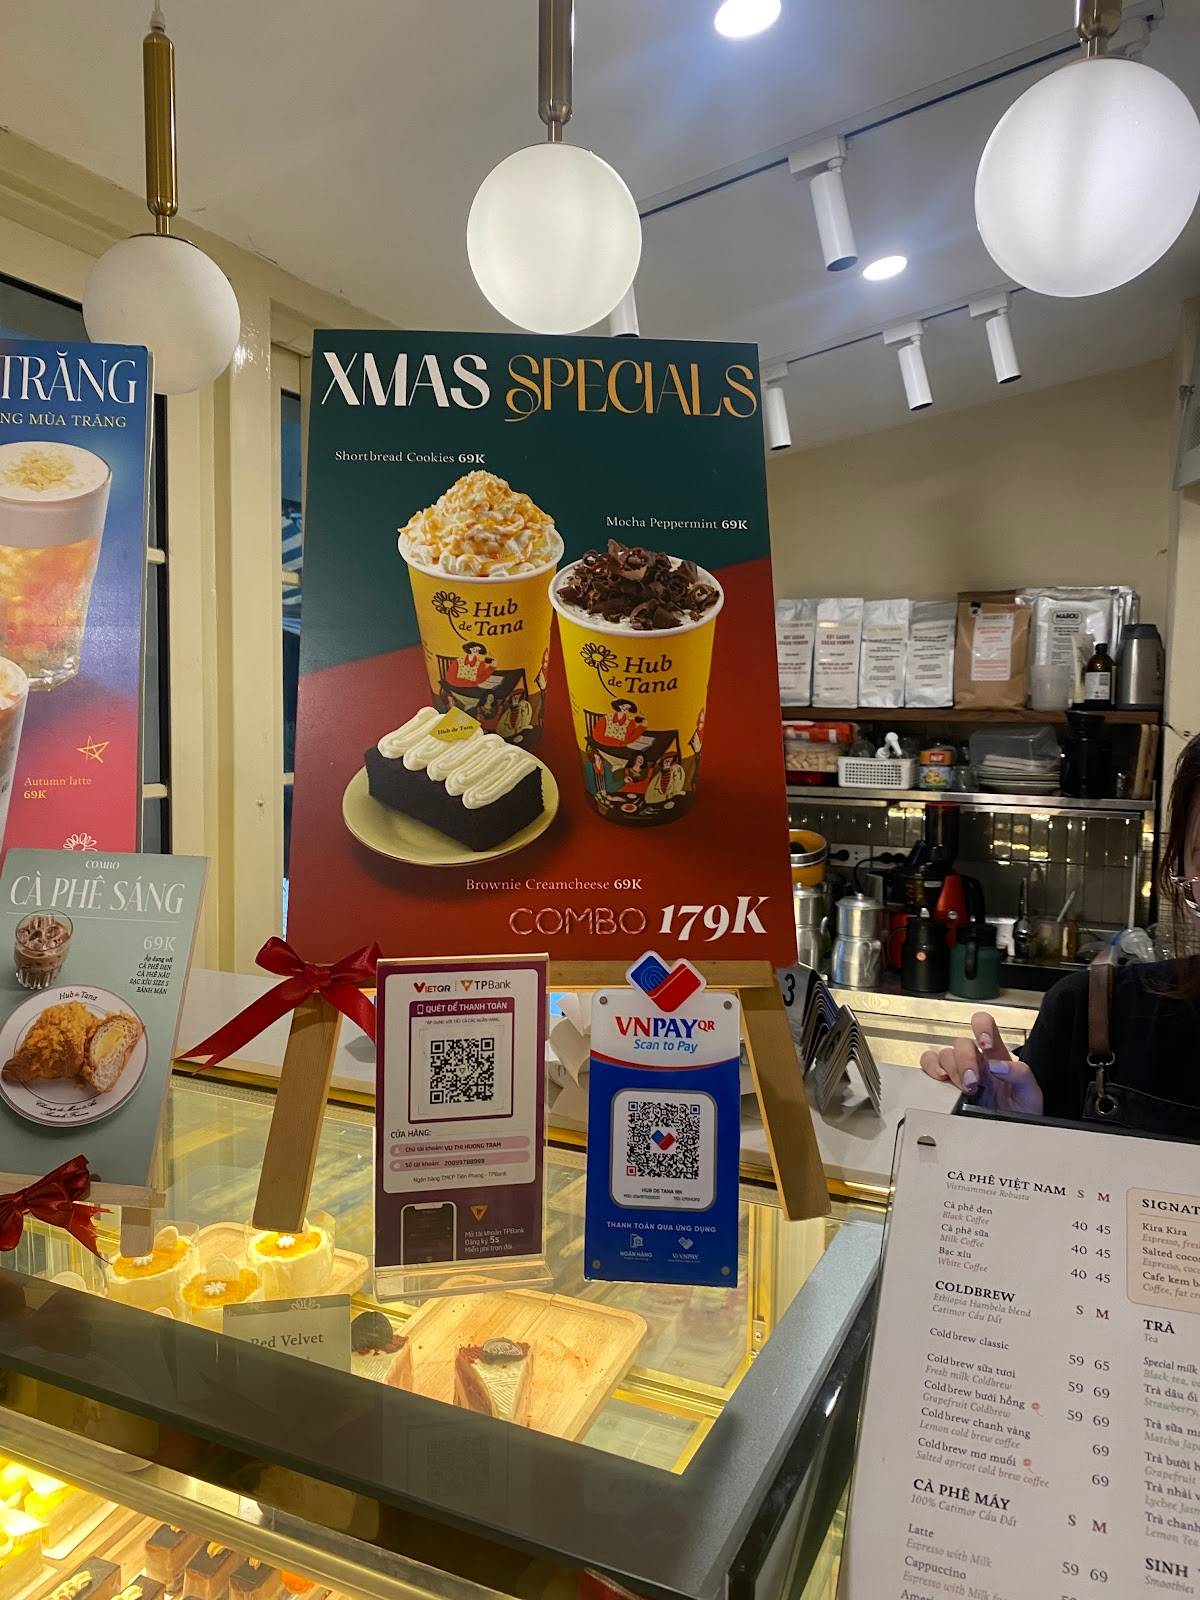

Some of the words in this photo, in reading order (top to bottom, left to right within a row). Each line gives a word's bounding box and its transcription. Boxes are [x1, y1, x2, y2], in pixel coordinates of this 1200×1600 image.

[0, 350, 137, 404] TRĂNG
[321, 351, 491, 411] XMAS
[504, 354, 757, 422] SPECIALS
[29, 411, 66, 426] MÙA
[72, 413, 126, 428] TRĂNG
[335, 449, 403, 463] Shortbread
[407, 450, 455, 464] Cookies
[458, 453, 485, 464] 69K
[606, 515, 646, 529] Mocha
[650, 516, 719, 533] Peppermint
[721, 519, 748, 530] 69K
[472, 598, 518, 618] Hub
[458, 620, 472, 632] de
[474, 617, 523, 636] Tana
[624, 653, 672, 674] Hub
[608, 676, 622, 687] de
[625, 676, 678, 693] Tana
[24, 777, 66, 787] Autumn
[69, 775, 92, 786] latte
[23, 790, 47, 800] 69K
[85, 859, 120, 870] COMBO
[10, 870, 42, 907] CÀ
[50, 875, 106, 910] PHÊ
[110, 875, 185, 914] SÁNG
[466, 878, 521, 890] Brownie
[525, 878, 610, 890] Creamcheese
[613, 879, 643, 890] 69K
[509, 907, 647, 935] COMBO
[659, 896, 771, 942] 179K
[143, 935, 176, 951] 69K
[475, 980, 511, 990] TPBank
[783, 973, 796, 1007] 3
[459, 1003, 485, 1011] THANH
[633, 1039, 660, 1050] Scan
[664, 1040, 674, 1050] to
[677, 1040, 698, 1054] Pay
[947, 1170, 965, 1181] CÀ
[969, 1174, 995, 1185] PHÊ
[999, 1177, 1030, 1191] VIỆT
[1033, 1183, 1066, 1196] NAM
[1076, 1189, 1085, 1199] S
[1097, 1192, 1110, 1202] M
[942, 1211, 963, 1221] Black
[965, 1214, 990, 1225] Coffee
[943, 1200, 955, 1209] Cà
[957, 1202, 974, 1212] phê
[976, 1205, 993, 1215] đen
[1072, 1220, 1088, 1231] 40
[1096, 1224, 1111, 1235] 45
[607, 1221, 632, 1229] THANH
[634, 1221, 655, 1230] TOÁN
[657, 1223, 673, 1231] QUA
[694, 1225, 717, 1234] DỤNG
[1141, 1222, 1163, 1232] Kira
[1166, 1226, 1187, 1236] Kira
[490, 1235, 500, 1243] 5s
[940, 1234, 959, 1243] Milk
[960, 1237, 985, 1248] Coffee
[941, 1223, 953, 1232] Cà
[955, 1225, 972, 1236] phê
[974, 1228, 989, 1238] sữa
[1071, 1244, 1087, 1255] 40
[1096, 1248, 1111, 1259] 45
[1142, 1246, 1173, 1259] Salted
[939, 1246, 955, 1257] Bạc
[1070, 1268, 1087, 1279] 40
[1095, 1273, 1111, 1283] 45
[963, 1261, 988, 1273] Coffee
[1142, 1271, 1165, 1282] Cafe
[1168, 1275, 1190, 1286] kem
[935, 1280, 1016, 1303] COLDBREW
[1075, 1304, 1084, 1315] S
[1095, 1308, 1109, 1320] M
[1143, 1319, 1175, 1334] TRÀ
[281, 1333, 324, 1347] Velvet
[1144, 1333, 1159, 1343] Tea
[979, 1337, 1010, 1350] classic
[1068, 1354, 1084, 1366] 59
[1094, 1359, 1110, 1371] 65
[925, 1365, 948, 1377] Fresh
[950, 1371, 970, 1383] milk
[1143, 1356, 1175, 1371] Special
[1177, 1363, 1198, 1375] milk
[977, 1363, 993, 1374] sữa
[996, 1367, 1016, 1378] tươi
[1067, 1381, 1084, 1394] 59
[1093, 1386, 1110, 1399] 69
[1143, 1384, 1161, 1396] Trà
[1165, 1387, 1184, 1400] dâu
[975, 1389, 996, 1403] bưởi
[999, 1394, 1025, 1410] hồng
[1066, 1409, 1083, 1422] 59
[1092, 1415, 1110, 1428] 69
[919, 1419, 949, 1434] Lemon
[995, 1437, 1021, 1449] coffee
[1143, 1417, 1162, 1430] Trà
[1165, 1422, 1183, 1435] sữa
[973, 1418, 1004, 1433] chanh
[1006, 1426, 1031, 1440] vàng
[1092, 1443, 1110, 1457] 69
[1144, 1451, 1163, 1465] Trà
[989, 1452, 1017, 1467] muối
[1091, 1474, 1109, 1487] 69
[1144, 1480, 1163, 1494] Trà
[913, 1478, 935, 1494] CÀ
[939, 1483, 970, 1502] PHÊ
[974, 1492, 1011, 1511] MÁY
[1067, 1513, 1077, 1527] S
[1091, 1519, 1107, 1535] M
[1144, 1511, 1163, 1525] Trà
[908, 1522, 935, 1538] Latte
[1062, 1561, 1080, 1577] 59
[1089, 1568, 1108, 1584] 69
[904, 1555, 967, 1580] Cappuccino
[1145, 1557, 1188, 1578] SINH
